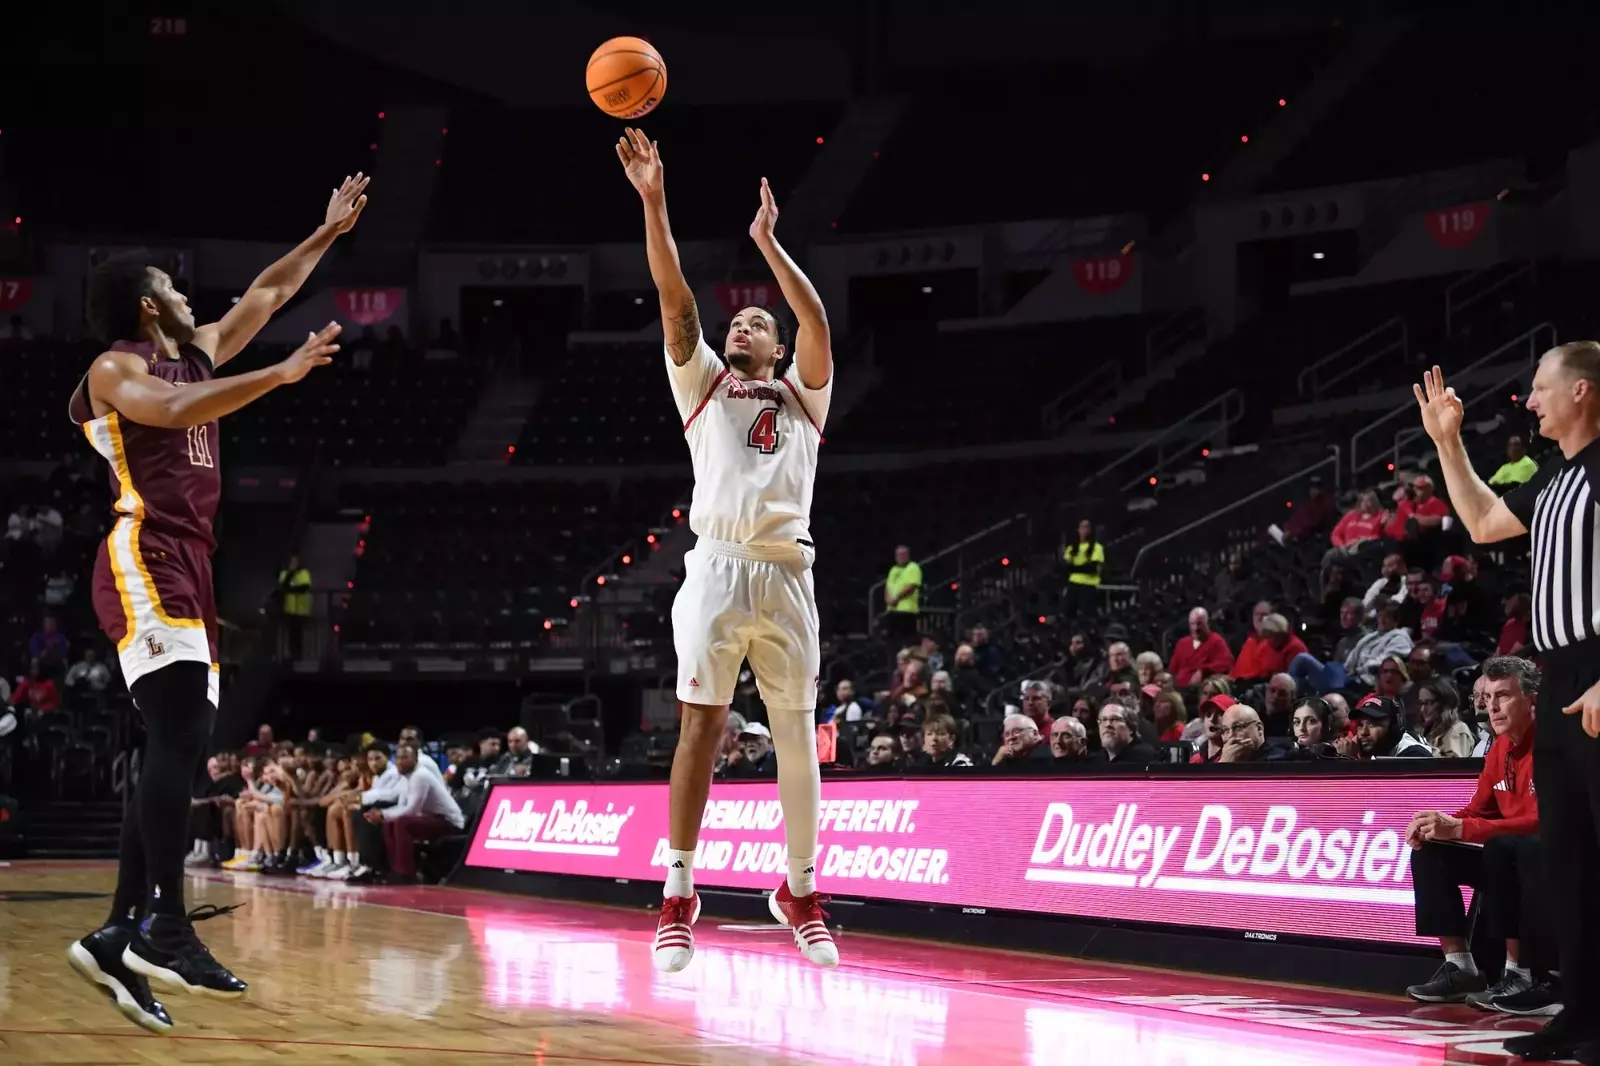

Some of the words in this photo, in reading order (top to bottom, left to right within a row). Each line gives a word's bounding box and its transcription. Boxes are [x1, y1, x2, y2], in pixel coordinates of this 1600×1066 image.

[1439, 209, 1475, 234] 119
[187, 424, 214, 468] 11
[747, 407, 779, 454] 4
[701, 799, 784, 831] DEMAND
[650, 837, 733, 871] DAND
[1030, 802, 1182, 888] Dudley
